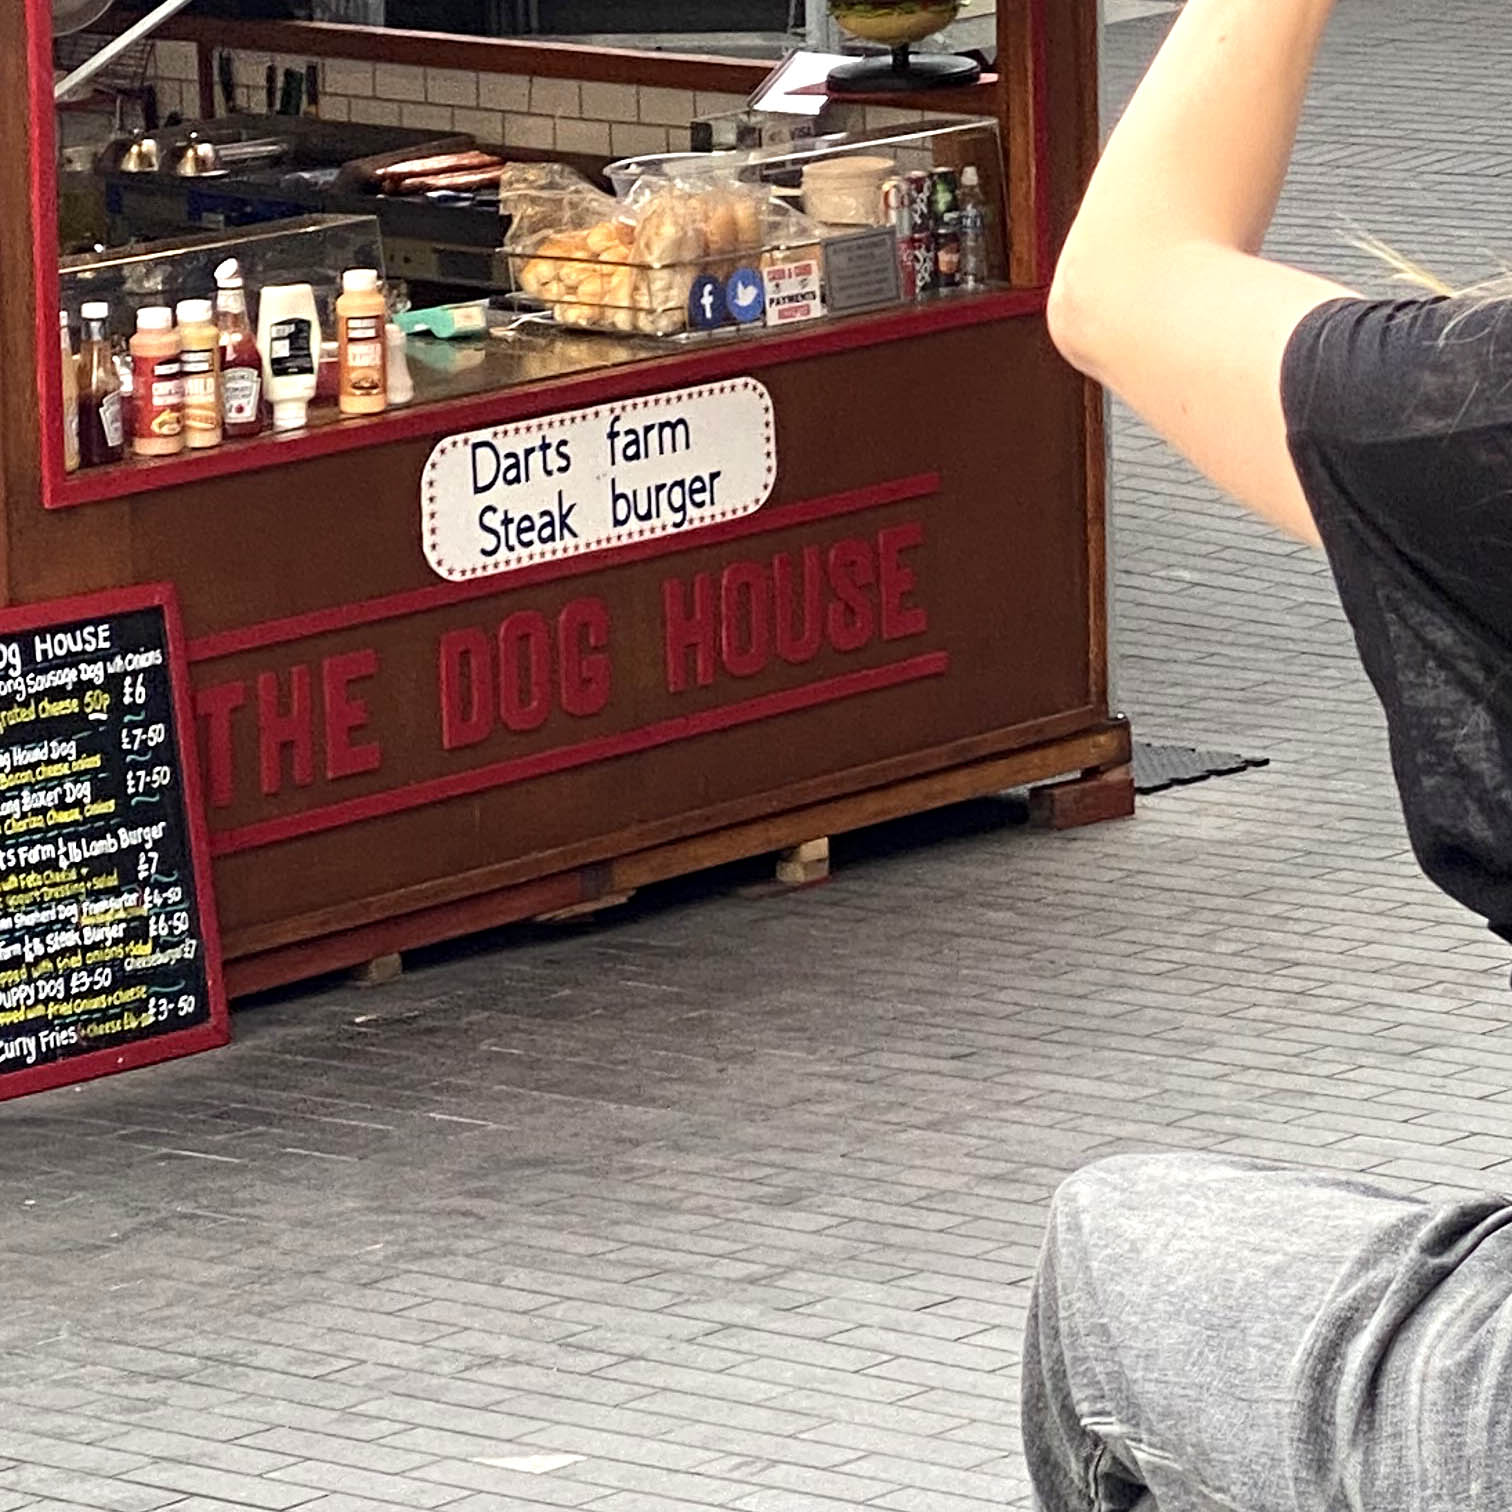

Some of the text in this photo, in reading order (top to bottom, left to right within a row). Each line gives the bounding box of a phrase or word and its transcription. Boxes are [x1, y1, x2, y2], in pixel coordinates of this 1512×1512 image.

[471, 414, 691, 495] Darts farm
[479, 470, 721, 557] Steak burger
[34, 624, 111, 662] HOUSE
[26, 667, 78, 691] Sausage
[79, 661, 104, 685] Dog
[198, 521, 928, 808] THE DOG HOUSE
[84, 689, 111, 713] 50p
[123, 673, 146, 705] £6
[49, 740, 77, 762] Dog
[64, 781, 91, 803] Dog
[17, 844, 55, 867] Farm
[81, 833, 118, 858] Lamb
[118, 821, 166, 849] Burger
[138, 852, 159, 880] £7
[57, 903, 78, 924] Dog
[83, 922, 127, 946] Burger
[39, 1025, 77, 1052] Fries
